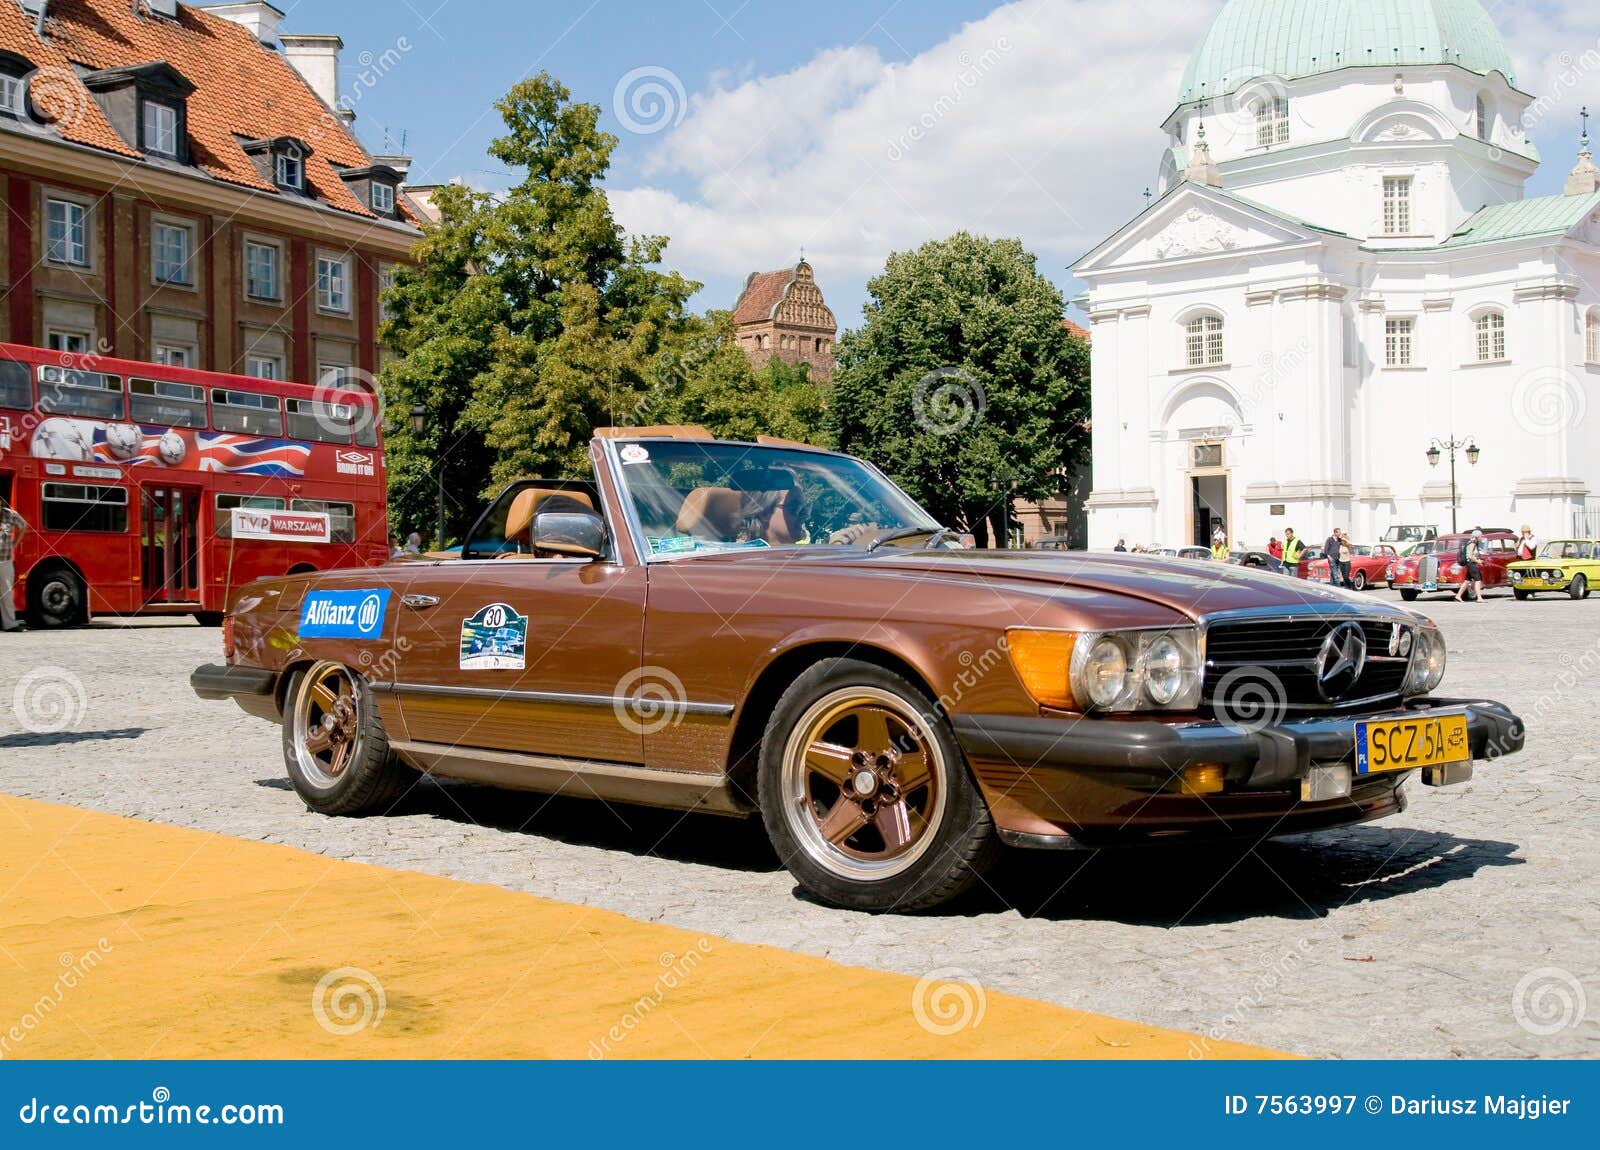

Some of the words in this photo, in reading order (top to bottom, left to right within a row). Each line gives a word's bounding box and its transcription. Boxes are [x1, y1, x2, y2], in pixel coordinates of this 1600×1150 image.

[238, 516, 269, 530] TVP
[273, 519, 324, 533] WARSZAWA
[304, 600, 357, 625] Allianz
[486, 608, 502, 626] 30
[1372, 725, 1418, 765] SCZ
[1424, 722, 1445, 760] 5A
[1358, 753, 1367, 764] PL
